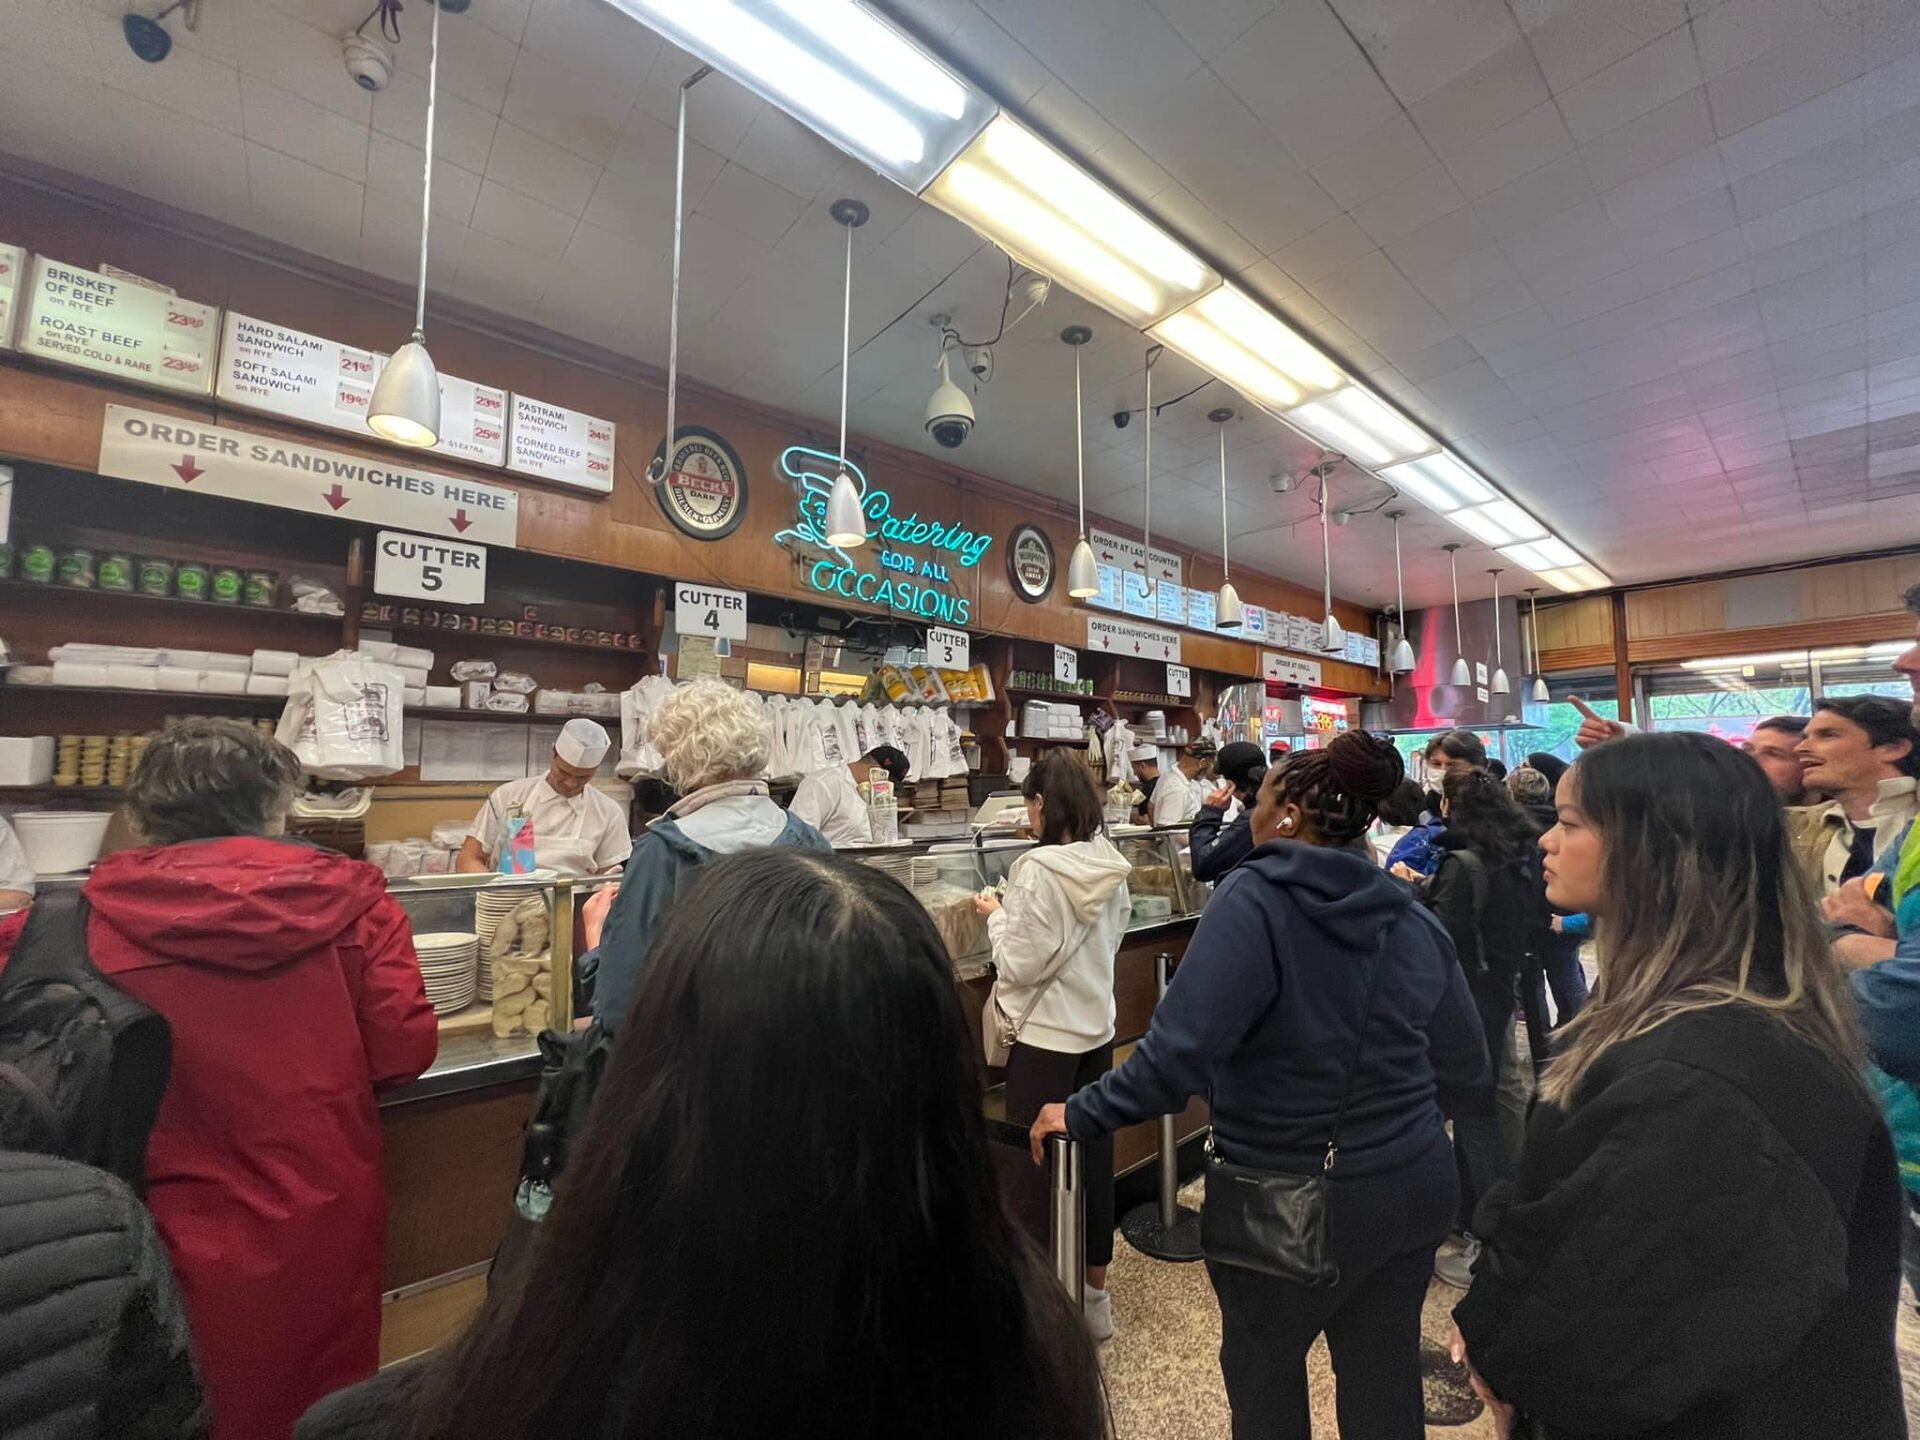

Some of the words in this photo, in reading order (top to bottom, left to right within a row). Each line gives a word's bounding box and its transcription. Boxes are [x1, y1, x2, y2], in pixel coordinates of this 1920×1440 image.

[47, 267, 117, 295] BRISKET
[45, 281, 68, 294] OF
[73, 288, 115, 307] BEEF
[49, 296, 65, 306] on
[69, 300, 93, 313] RYE
[40, 315, 98, 338] ROAST
[101, 332, 143, 349] BEEF
[46, 330, 61, 339] on
[64, 333, 89, 346] RYE
[237, 321, 274, 338] HARD
[277, 332, 323, 352] SALAMI
[37, 337, 81, 354] SERVED
[83, 348, 112, 362] COLD
[114, 357, 122, 365] &
[124, 358, 152, 372] RARE
[236, 333, 304, 357] SANDWICH
[239, 346, 252, 355] on
[253, 349, 273, 359] RYE
[232, 370, 301, 393] SANDWICH
[233, 358, 268, 373] SOFT
[271, 367, 317, 386] SALAMI
[235, 384, 248, 392] on
[250, 386, 270, 397] RYE
[518, 401, 565, 421] PASTRAMI
[518, 411, 568, 432] SANDWICH
[531, 424, 545, 435] RYE
[515, 446, 566, 466] SANDWICH
[516, 435, 556, 453] CORNED
[558, 446, 582, 459] BEEF
[124, 418, 240, 457] ORDER
[250, 445, 435, 496] SANDWICHES
[444, 485, 506, 511] HERE
[529, 459, 543, 469] RYE
[690, 490, 716, 501] DARK
[860, 490, 993, 566] Catering
[382, 540, 480, 569] CUTTER
[1093, 535, 1118, 550] ORDER
[1120, 543, 1129, 552] AT
[1149, 553, 1179, 568] COUNTER
[881, 550, 916, 574] FOR
[921, 561, 950, 583] ALL
[421, 565, 443, 591] 5
[679, 590, 742, 611] CUTTER
[811, 560, 971, 625] OCCASIONS
[704, 609, 720, 630] 4
[929, 631, 967, 648] CUTTER
[1091, 622, 1116, 633] ORDER
[1118, 627, 1161, 641] SANDWICHES
[1161, 635, 1178, 644] HERE
[944, 646, 953, 663] 3
[1055, 649, 1075, 663] CUTTER
[1063, 662, 1069, 678] 2
[1168, 667, 1189, 679] CUTTER
[1176, 679, 1181, 692] 1
